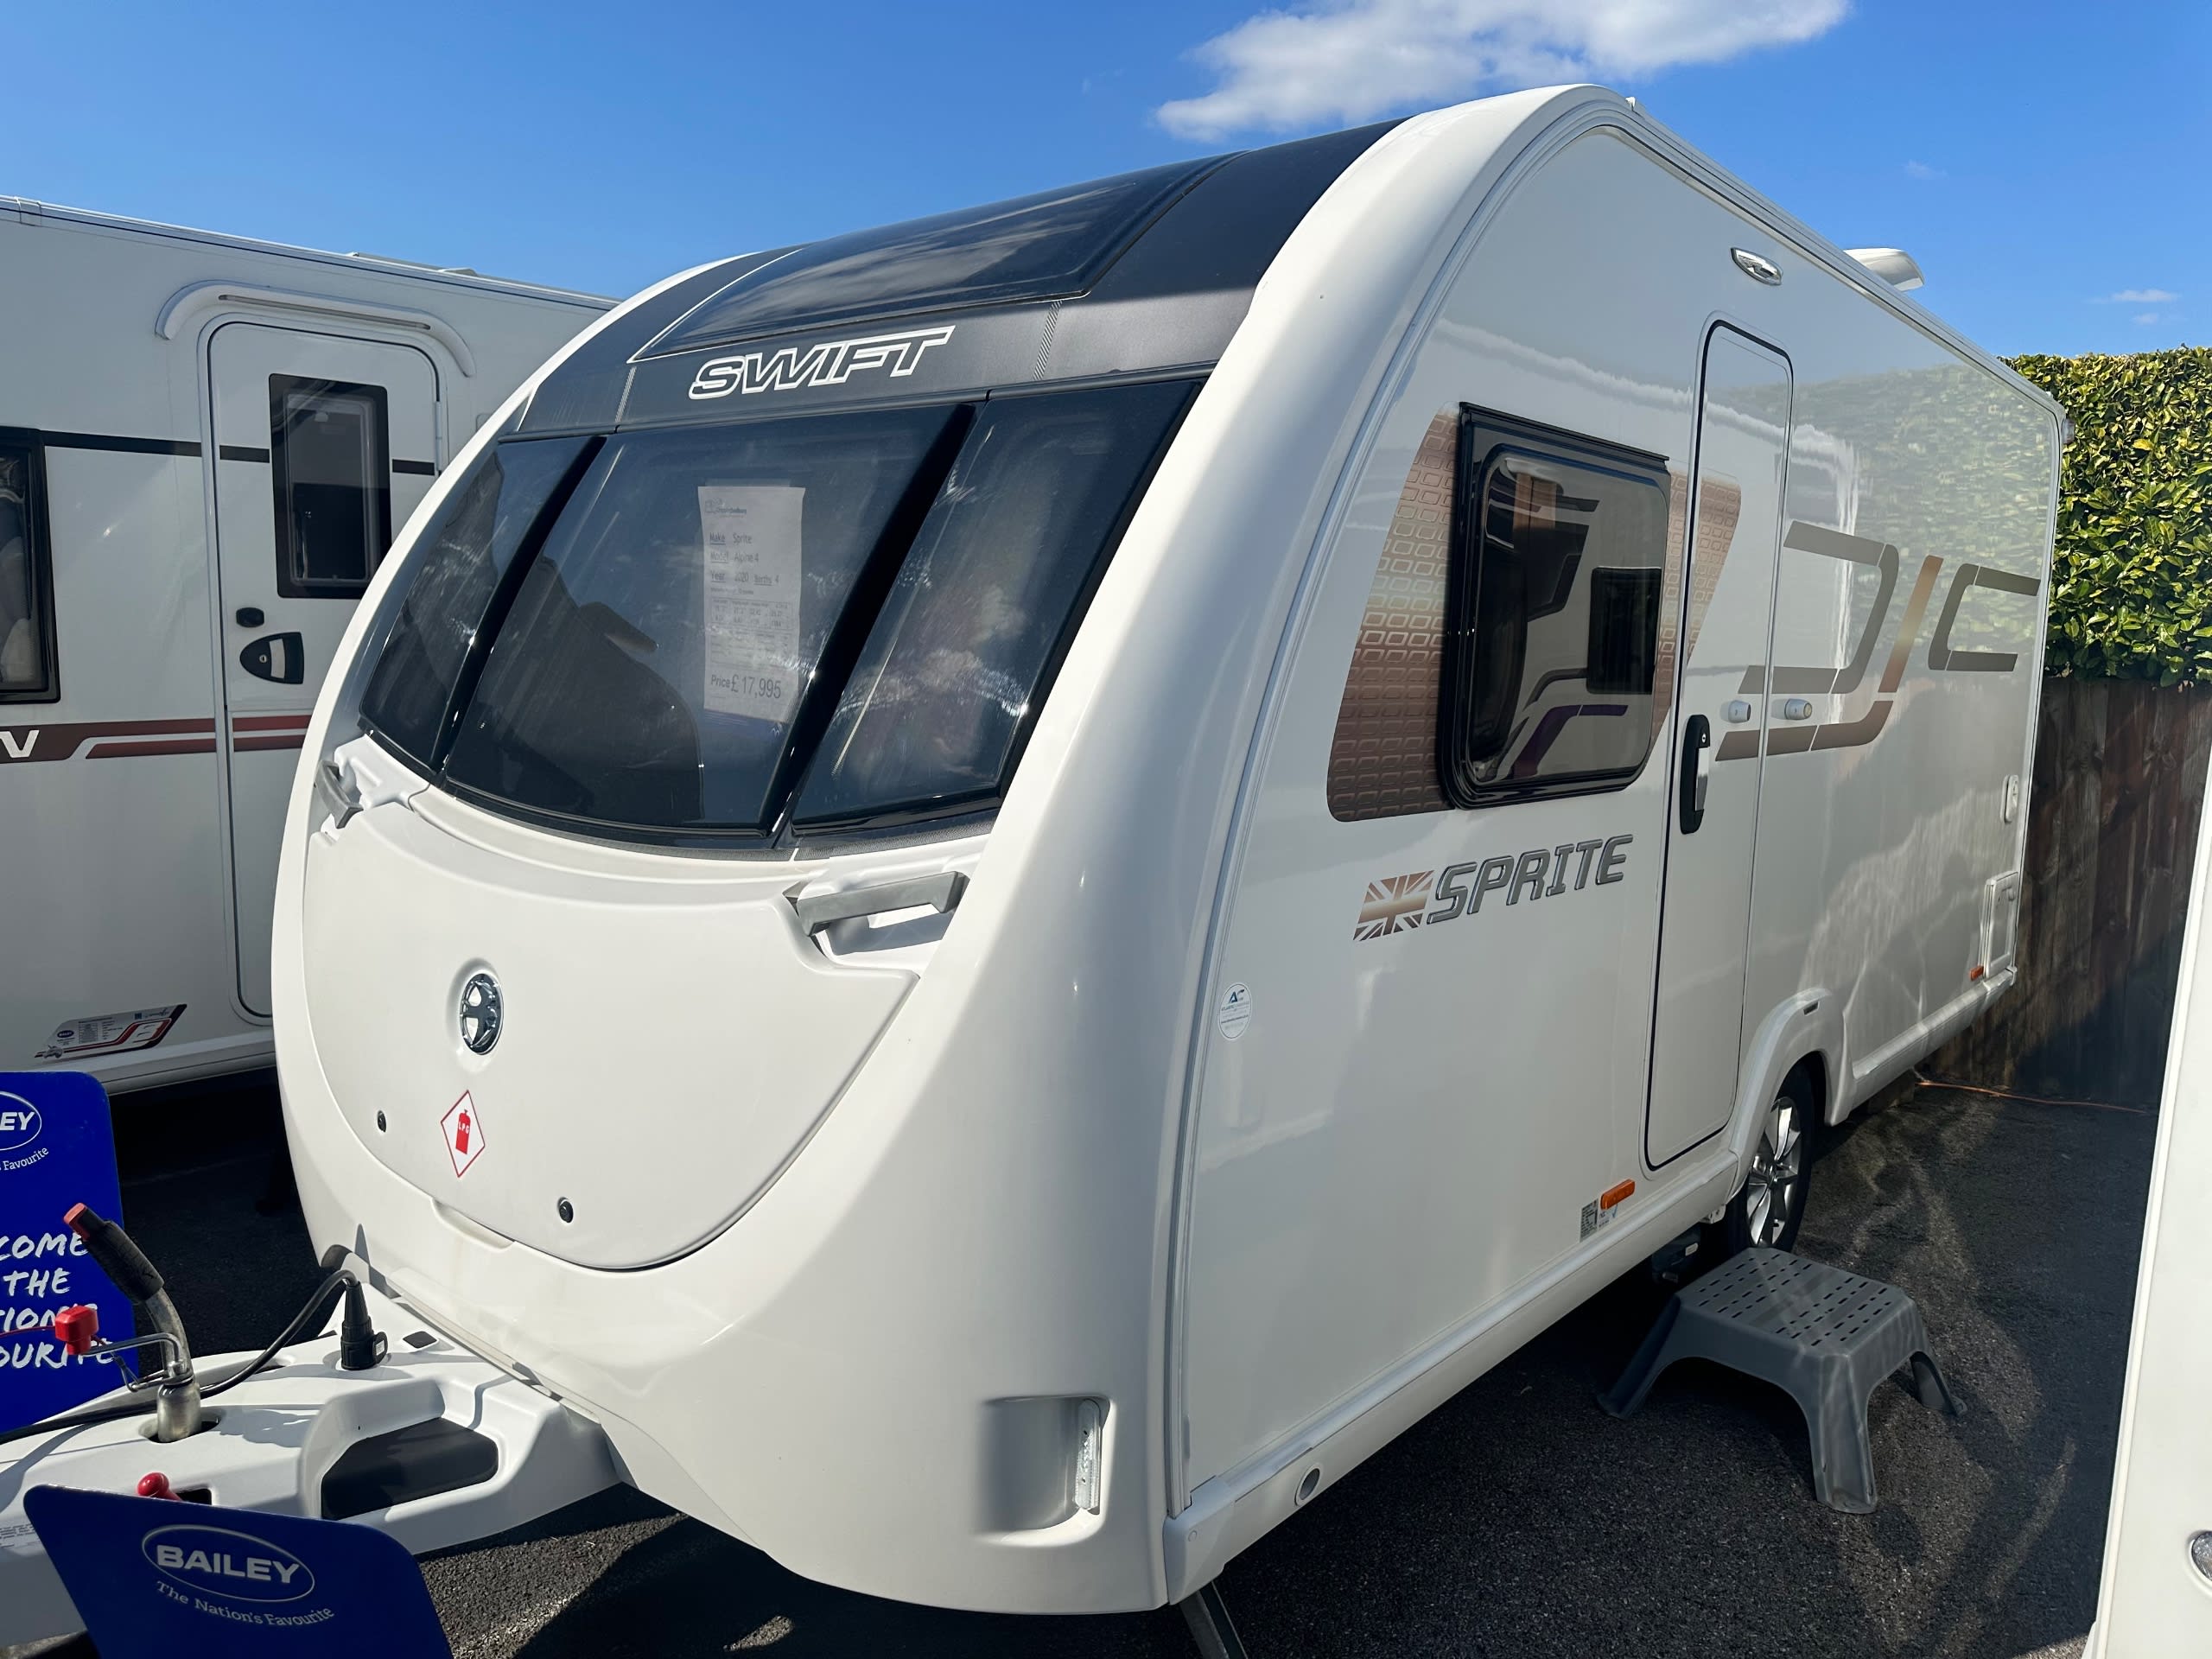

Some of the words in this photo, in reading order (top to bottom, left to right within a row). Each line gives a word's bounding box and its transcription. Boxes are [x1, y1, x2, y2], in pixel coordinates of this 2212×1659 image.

[688, 325, 956, 399] SWIFT
[732, 532, 753, 545] Sprite
[710, 570, 726, 582] Year
[710, 674, 731, 688] Price
[1426, 834, 1634, 925] SPRITE
[458, 1121, 470, 1135] LPG
[2, 1147, 49, 1171] Favourite
[3, 1268, 71, 1298] THE
[156, 1544, 300, 1584] BAILEY
[156, 1580, 189, 1604] The
[194, 1599, 264, 1624] Nation's
[264, 1607, 335, 1626] Favourite
